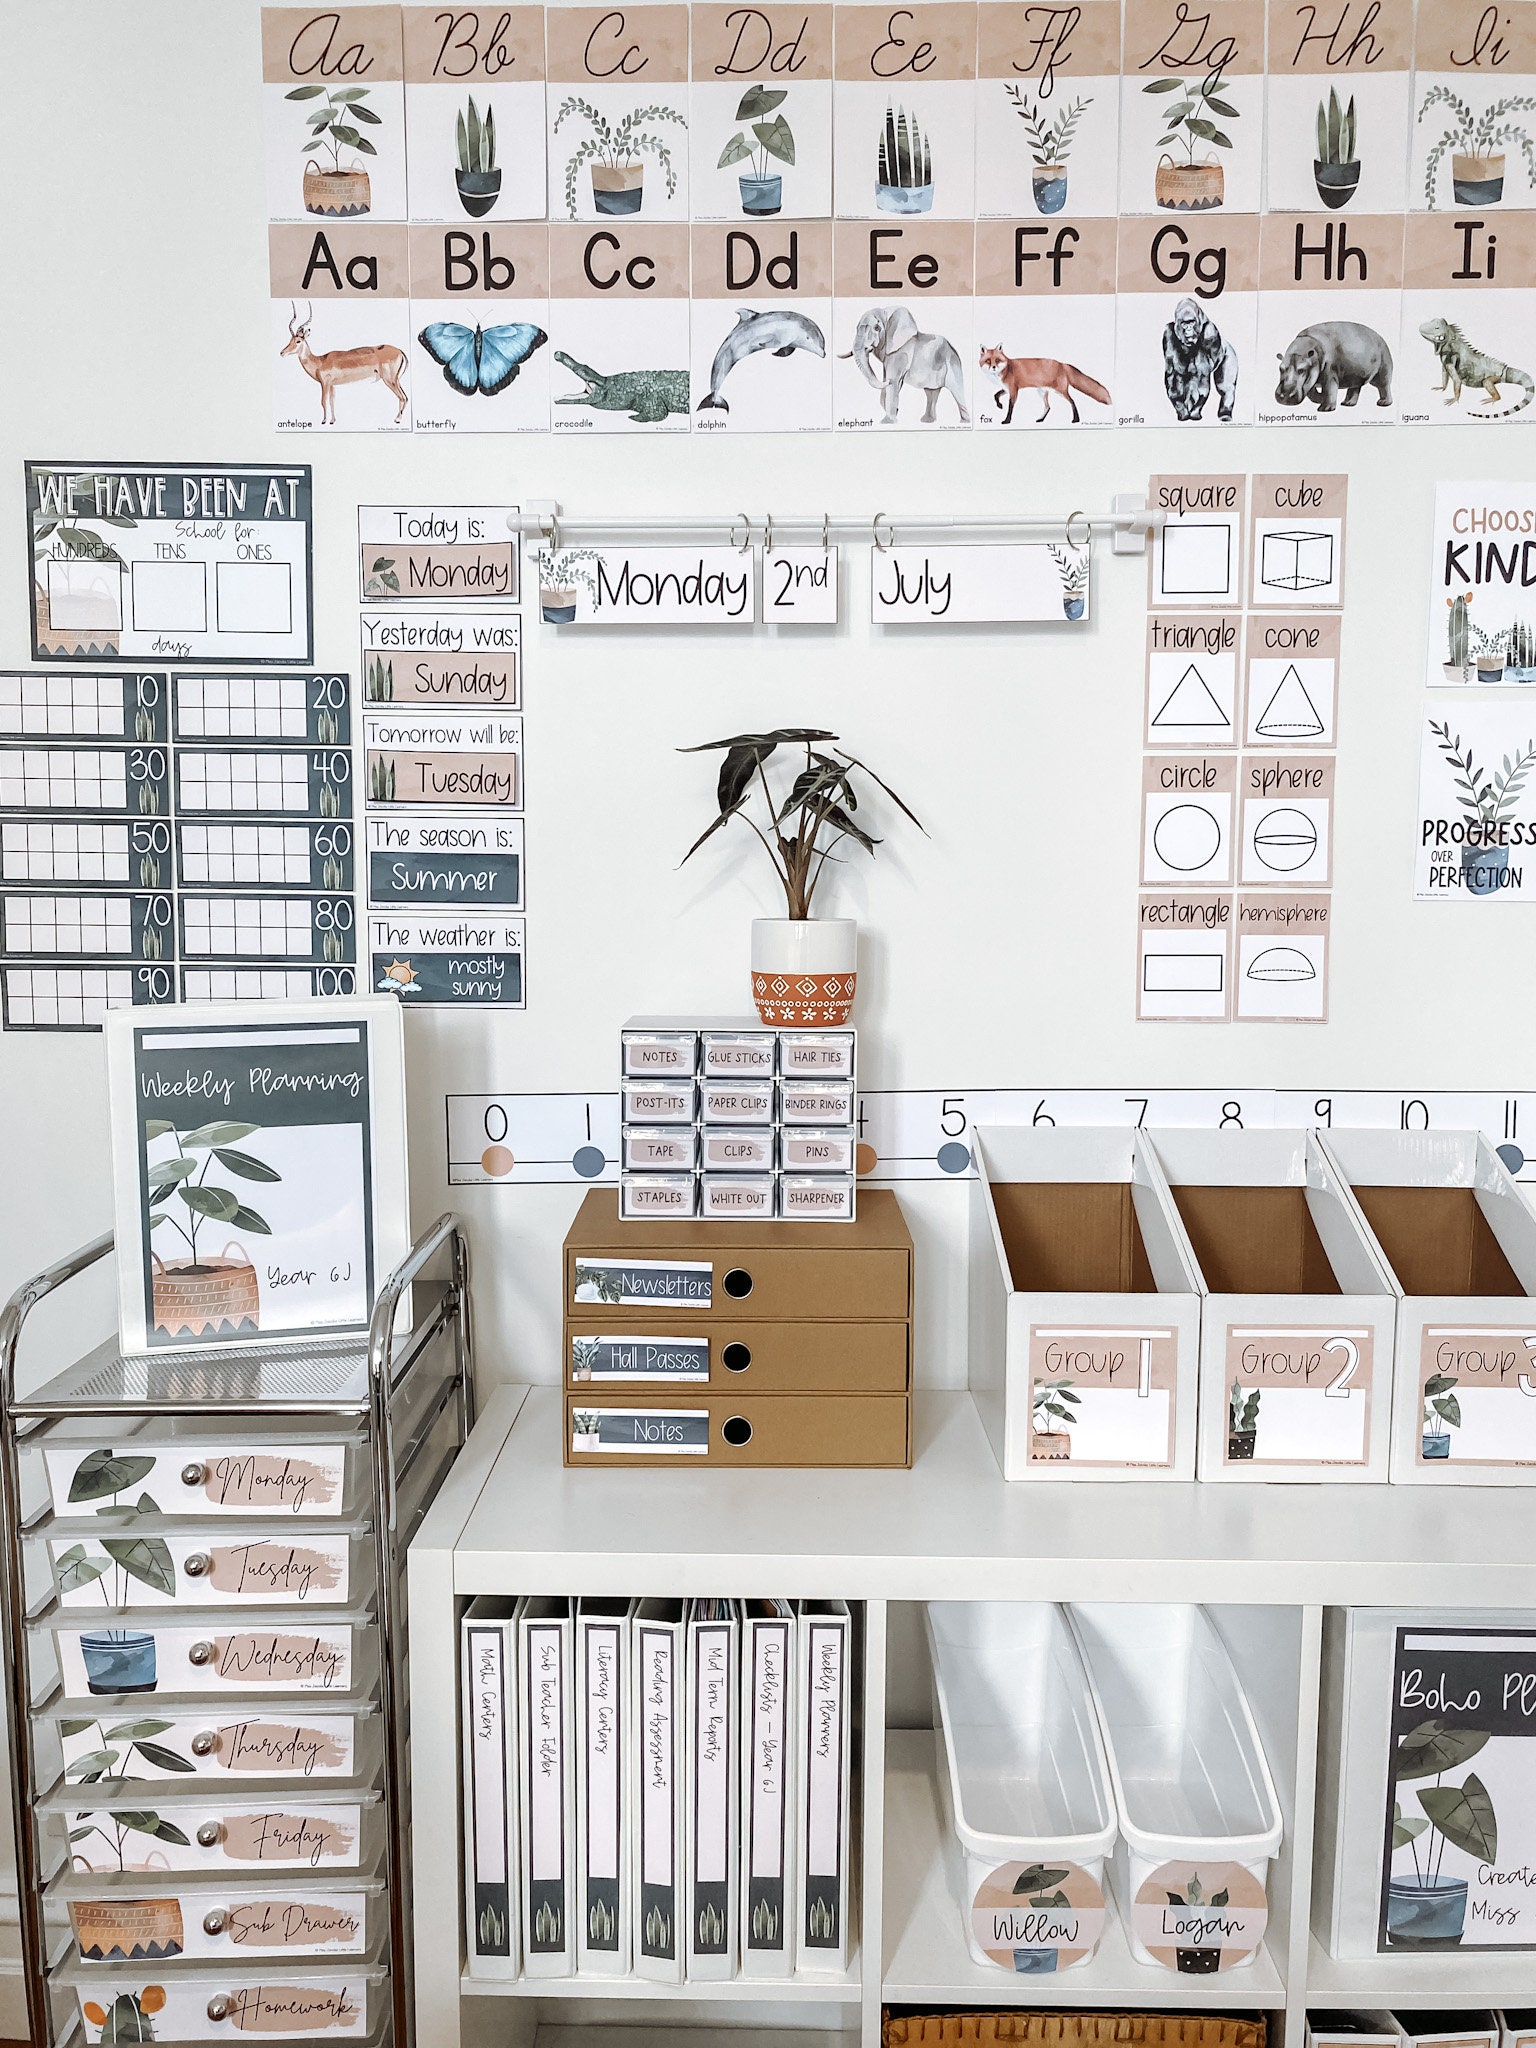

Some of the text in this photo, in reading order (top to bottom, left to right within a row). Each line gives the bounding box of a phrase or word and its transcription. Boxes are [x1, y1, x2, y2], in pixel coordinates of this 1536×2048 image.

[289, 13, 374, 76] Aa
[432, 12, 515, 76] Bb
[584, 11, 649, 76] Cc
[715, 10, 808, 76] Dd
[870, 11, 937, 76] Ee
[1292, 1, 1384, 66] Hh
[1450, 6, 1511, 66] Ii
[1012, 7, 1081, 98] Ff
[1138, 3, 1238, 97] Gg
[302, 231, 378, 290] Aa
[445, 231, 515, 291] Bb
[584, 231, 656, 290] Cc
[727, 231, 798, 290] Dd
[870, 229, 939, 289] Ee
[1015, 227, 1080, 287] Ff
[1151, 224, 1227, 299] Gg
[1295, 223, 1367, 281] Hh
[1452, 222, 1498, 280] Ii
[277, 419, 313, 430] antelope
[416, 419, 456, 431] butterfly
[555, 419, 593, 428] crocodile
[698, 419, 727, 430] dolphin
[838, 418, 874, 429] elephant
[980, 414, 993, 424] fox
[1118, 415, 1145, 426] gorilla
[1258, 412, 1317, 424] hippopotamus
[1402, 413, 1430, 423] iguana
[37, 475, 299, 519] WE HAVE BEEN AT
[1158, 485, 1237, 517] square
[1275, 480, 1323, 507] cube
[175, 521, 226, 540] School
[394, 512, 485, 544] Today is:
[1453, 507, 1536, 534] CHOOS
[52, 542, 117, 558] HUNDREDS
[153, 543, 186, 560] TENS
[236, 544, 272, 561] ONES
[409, 556, 508, 592] Monday
[598, 559, 749, 616] Monday
[773, 557, 829, 606] 2nd
[878, 558, 952, 616] July
[151, 635, 193, 658] days
[363, 619, 518, 653] Yesterday was:
[1151, 618, 1236, 655] triangle
[1265, 627, 1320, 648] cone
[136, 675, 159, 707] 10
[312, 676, 346, 709] 20
[414, 664, 508, 702] Sunday
[367, 723, 519, 744] Tomorrow will be:
[129, 749, 165, 780] 30
[313, 751, 349, 783] 40
[1160, 759, 1217, 788] circle
[1251, 761, 1323, 796] sphere
[414, 762, 511, 802] Tuesday
[132, 821, 170, 853] 50
[314, 824, 351, 857] 60
[370, 822, 513, 848] The season is:
[1431, 851, 1453, 862] OVER
[391, 863, 498, 891] Summer
[1430, 867, 1522, 888] PERFECTION
[135, 895, 172, 927] 70
[315, 899, 353, 931] 80
[1141, 898, 1230, 929] rectangle
[1240, 903, 1328, 927] hemisphere
[372, 922, 521, 947] The weather is:
[138, 967, 170, 998] 90
[315, 967, 356, 997] 100
[448, 955, 505, 979] mostly
[452, 981, 501, 1000] sunny
[642, 1051, 678, 1062] NOTES
[708, 1052, 772, 1064] GLUE STICKS
[794, 1051, 842, 1062] HAIR TIES
[141, 1067, 364, 1105] Weekly Planning
[636, 1097, 685, 1108] POST-ITS
[708, 1097, 768, 1108] PAPER CLIPS
[785, 1098, 847, 1110] BINDER RINGS
[941, 1099, 966, 1137] 5
[1125, 1099, 1149, 1128] 7
[1401, 1100, 1429, 1130] 10
[484, 1104, 508, 1142] 0
[1505, 1100, 1517, 1139] 11
[648, 1145, 674, 1157] TAPE
[724, 1145, 752, 1157] CLIPS
[806, 1146, 829, 1157] PINS
[636, 1192, 682, 1203] STAPLES
[711, 1193, 767, 1204] WHITE OUT
[789, 1193, 845, 1204] SHARPENER
[267, 1266, 317, 1289] Year
[621, 1272, 712, 1297] Newsletters
[610, 1346, 700, 1370] Hall Passes
[1045, 1338, 1150, 1398] Group 1
[1242, 1336, 1360, 1399] Group 2
[1436, 1341, 1516, 1382] Group
[633, 1418, 684, 1443] Notes
[216, 1455, 314, 1513] Monday
[231, 1540, 319, 1600] Tuesday
[221, 1636, 344, 1687] Wednesday
[479, 1648, 497, 1740] Math Centers
[760, 1643, 779, 1714] Checklists
[1400, 1669, 1481, 1712] Boho
[540, 1646, 557, 1777] Sub Teacher Folder
[592, 1646, 613, 1754] Literacy Centers
[703, 1647, 724, 1762] Mid Term Reports
[815, 1644, 836, 1758] Weekly Planners
[649, 1650, 668, 1788] Reading Assessment
[221, 1719, 325, 1775] Thursday
[762, 1739, 778, 1771] Year
[250, 1813, 331, 1866] Friday
[230, 1905, 360, 1943] Sub Drawer
[993, 1913, 1079, 1942] Willow
[1162, 1909, 1245, 1944] Logan
[1472, 1900, 1521, 1925] Miss
[228, 1986, 353, 2030] Homework
